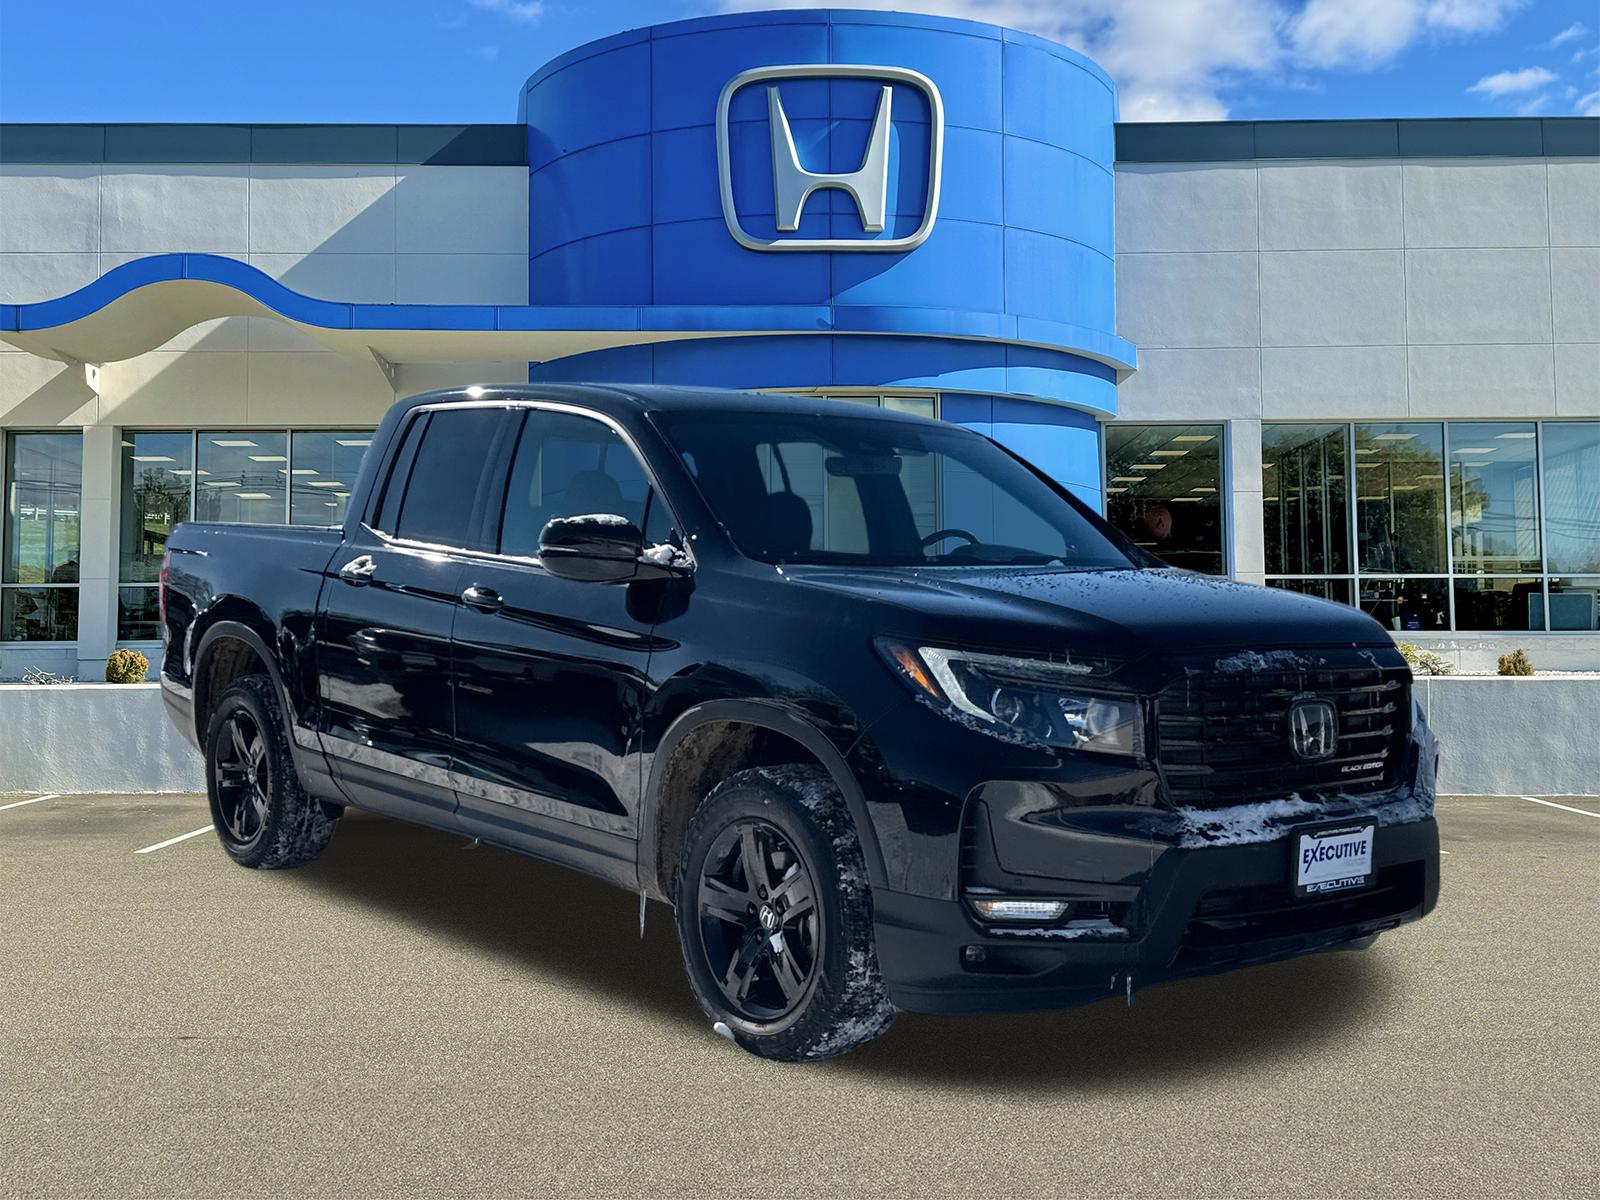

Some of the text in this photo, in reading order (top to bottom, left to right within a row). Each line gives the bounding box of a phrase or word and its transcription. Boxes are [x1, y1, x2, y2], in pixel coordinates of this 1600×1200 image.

[1341, 761, 1384, 773] BLACK EDITION
[1303, 840, 1367, 874] EXECUTIVE
[1306, 876, 1365, 893] EXECUTIVE
